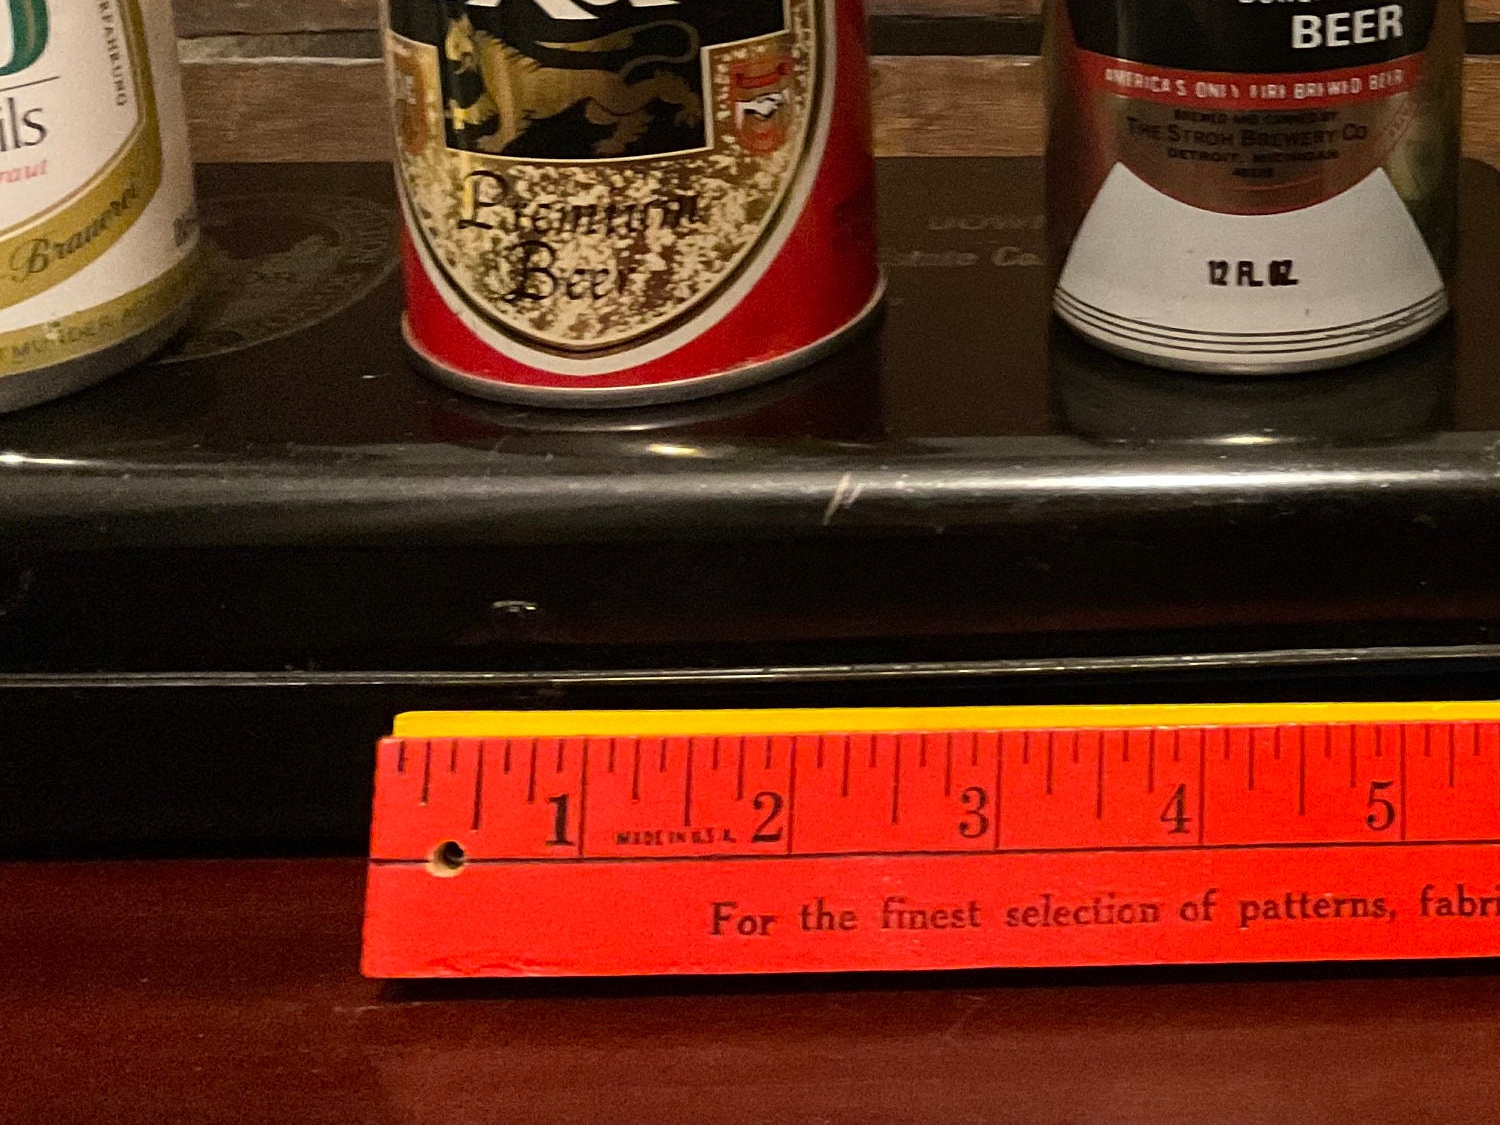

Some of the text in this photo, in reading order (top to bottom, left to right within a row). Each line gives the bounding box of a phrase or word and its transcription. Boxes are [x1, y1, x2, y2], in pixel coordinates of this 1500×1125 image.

[1291, 3, 1404, 50] BEER
[545, 792, 575, 848] 1
[750, 790, 785, 844] 2
[957, 785, 991, 839] 3
[1159, 782, 1192, 836] 4
[1365, 779, 1397, 832] 5
[709, 899, 778, 937] For
[799, 896, 859, 932] the
[880, 895, 982, 931] finest
[1005, 892, 1161, 928] selection
[1179, 888, 1220, 923] of
[1238, 890, 1397, 929] patterns,
